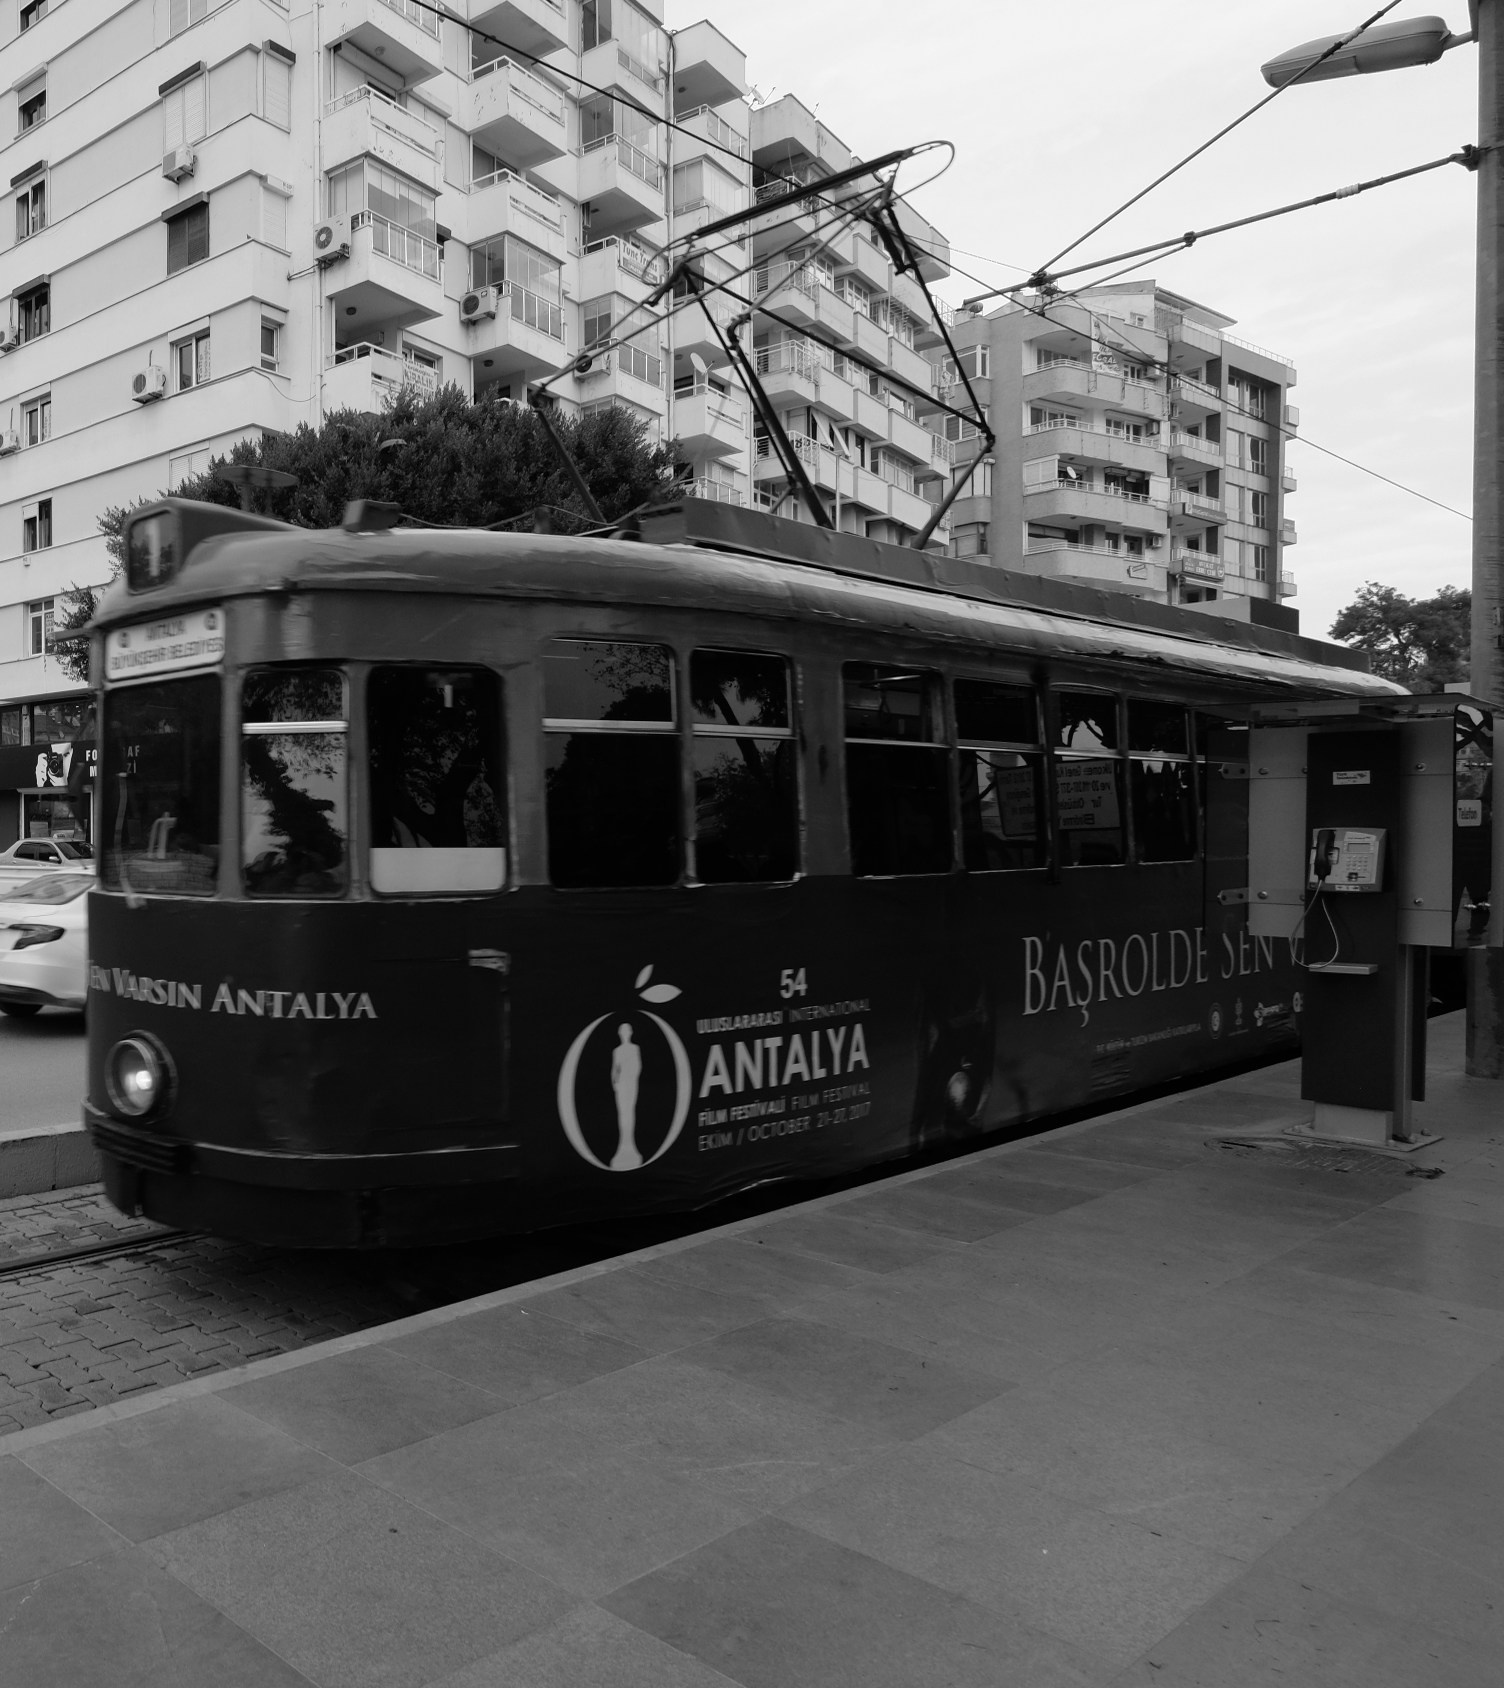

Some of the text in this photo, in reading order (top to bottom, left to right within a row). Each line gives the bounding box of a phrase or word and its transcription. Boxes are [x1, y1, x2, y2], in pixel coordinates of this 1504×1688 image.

[112, 967, 202, 1010] VARSIN
[210, 983, 379, 1020] ANTALYA
[779, 967, 808, 999] 54
[1022, 927, 1209, 1028] BAŞROLDE
[698, 1022, 872, 1099] ANTALYA
[747, 1115, 813, 1142] OCTOBER
